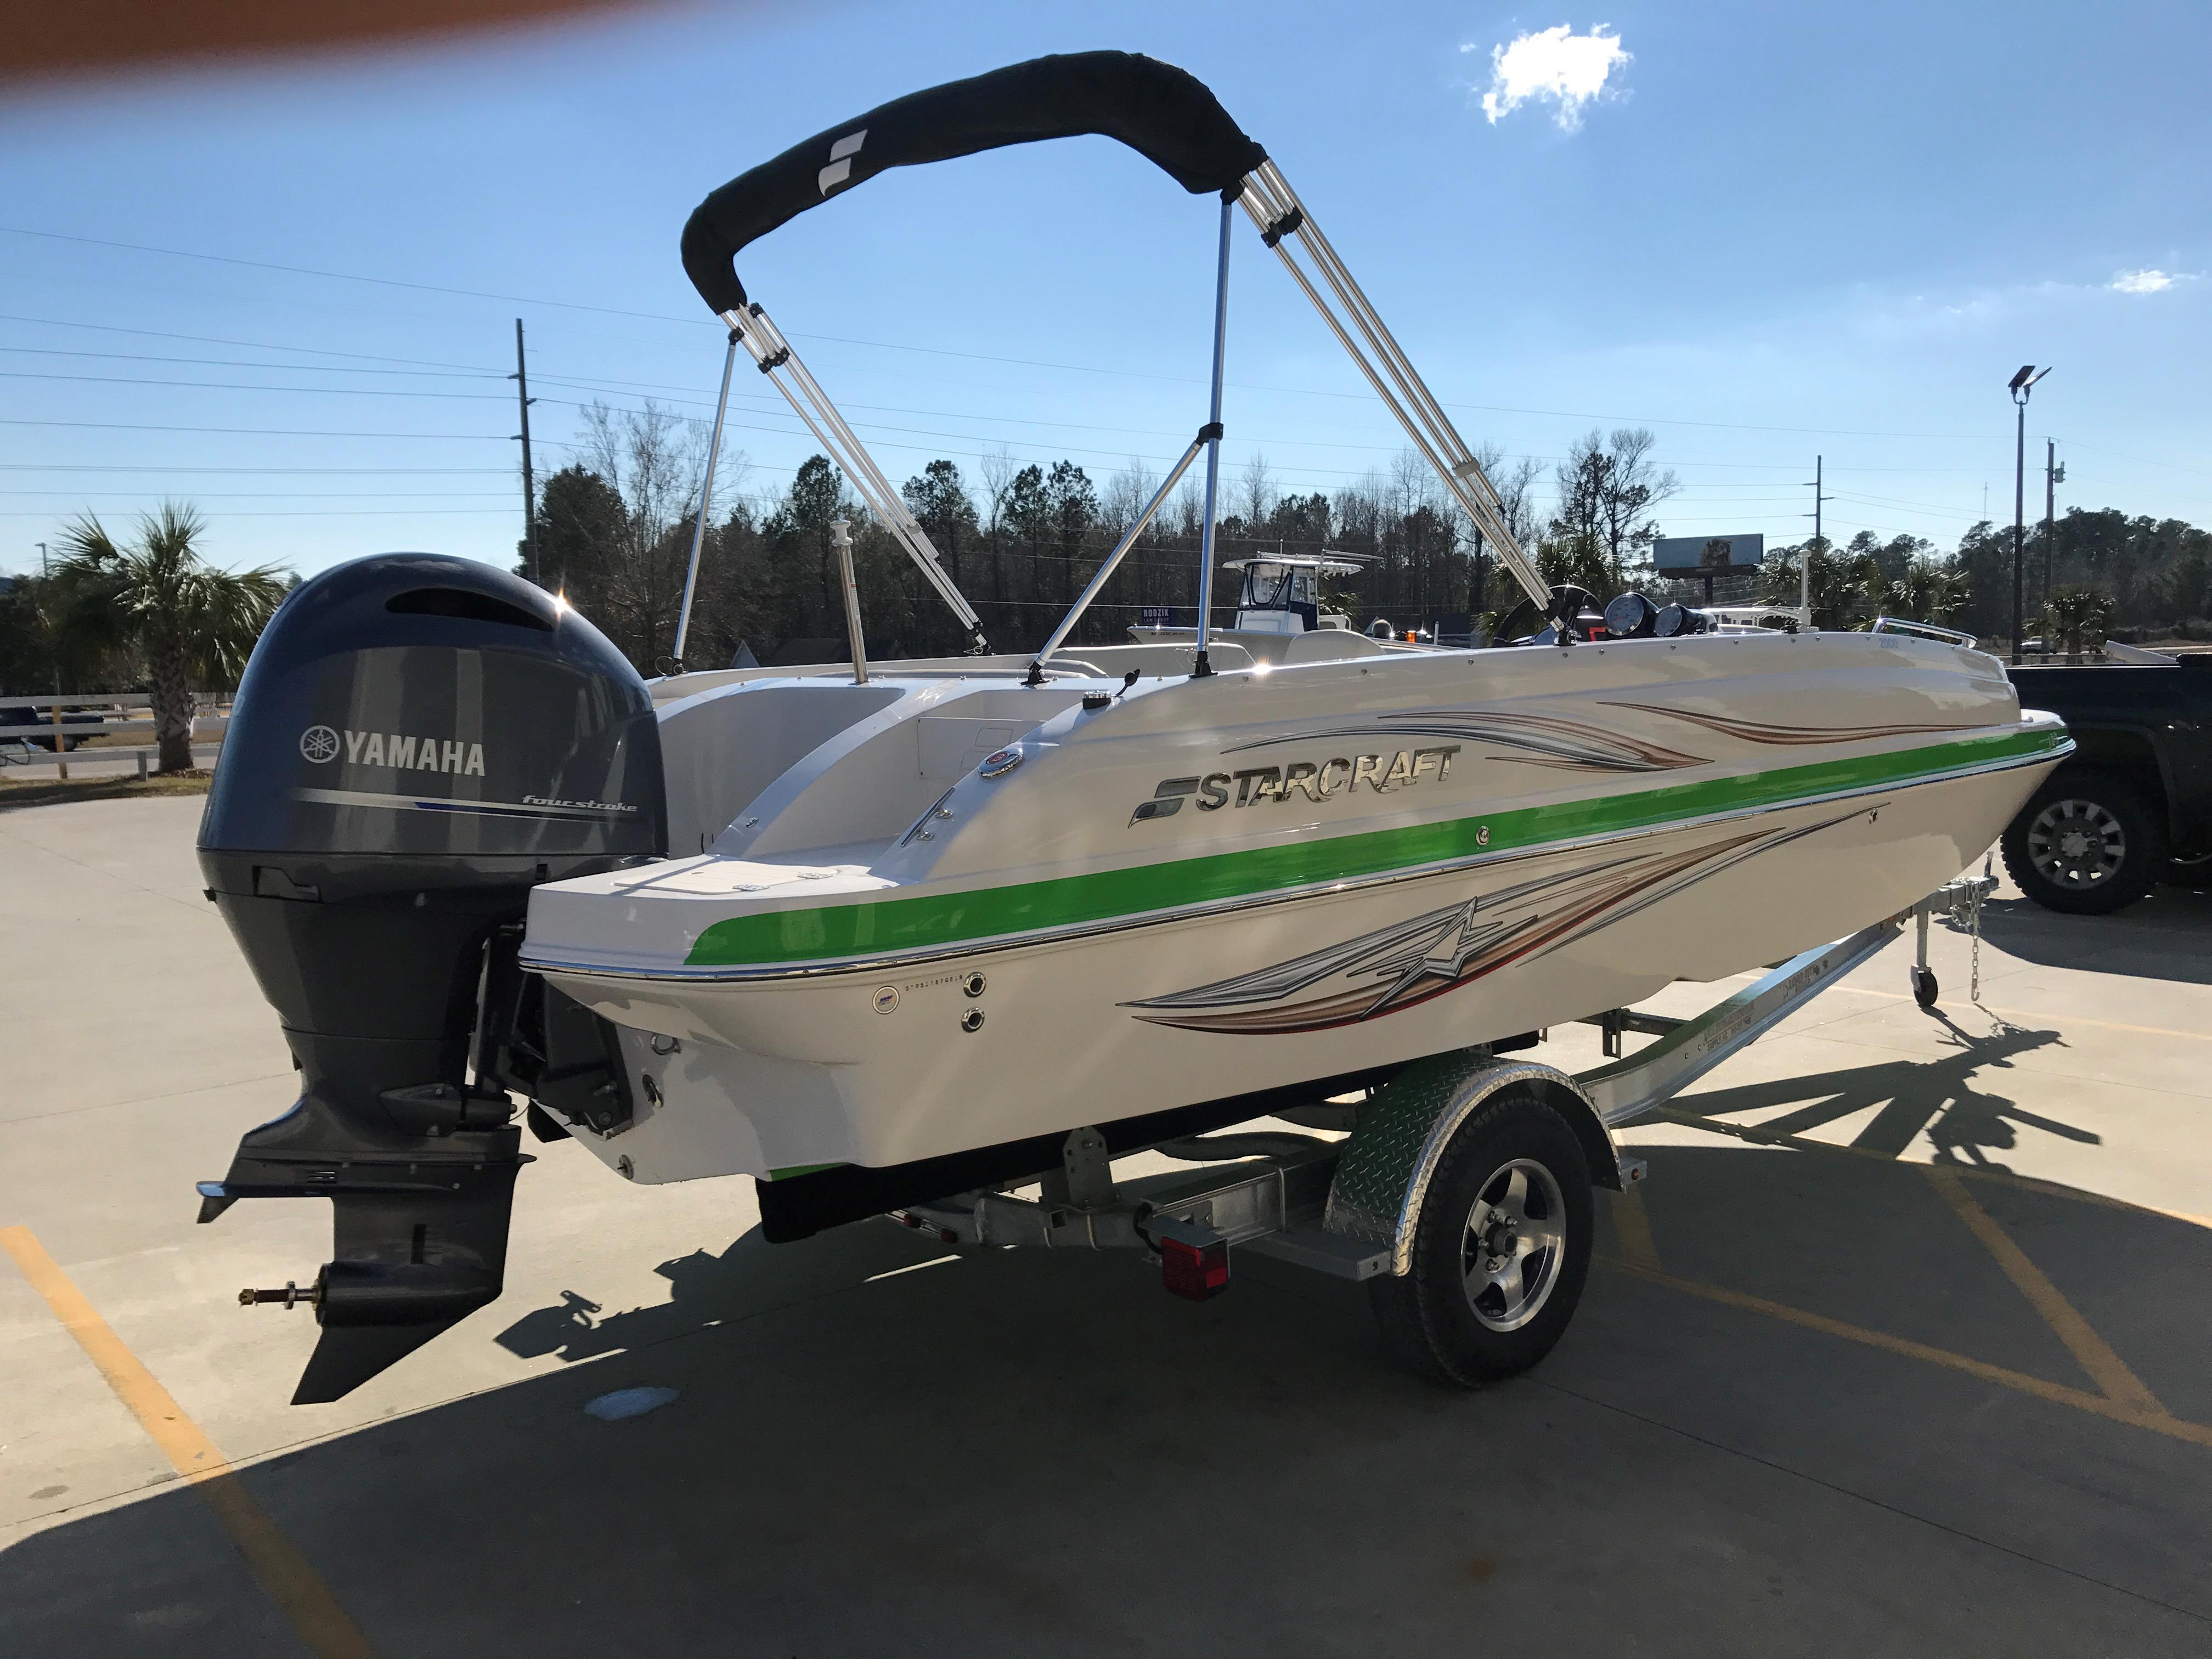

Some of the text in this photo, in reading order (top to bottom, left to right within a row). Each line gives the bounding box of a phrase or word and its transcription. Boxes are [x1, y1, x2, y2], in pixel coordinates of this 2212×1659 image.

[1143, 608, 1169, 617] RODZIK
[344, 730, 485, 776] YAMAHA
[1196, 745, 1461, 811] STARCRAFT
